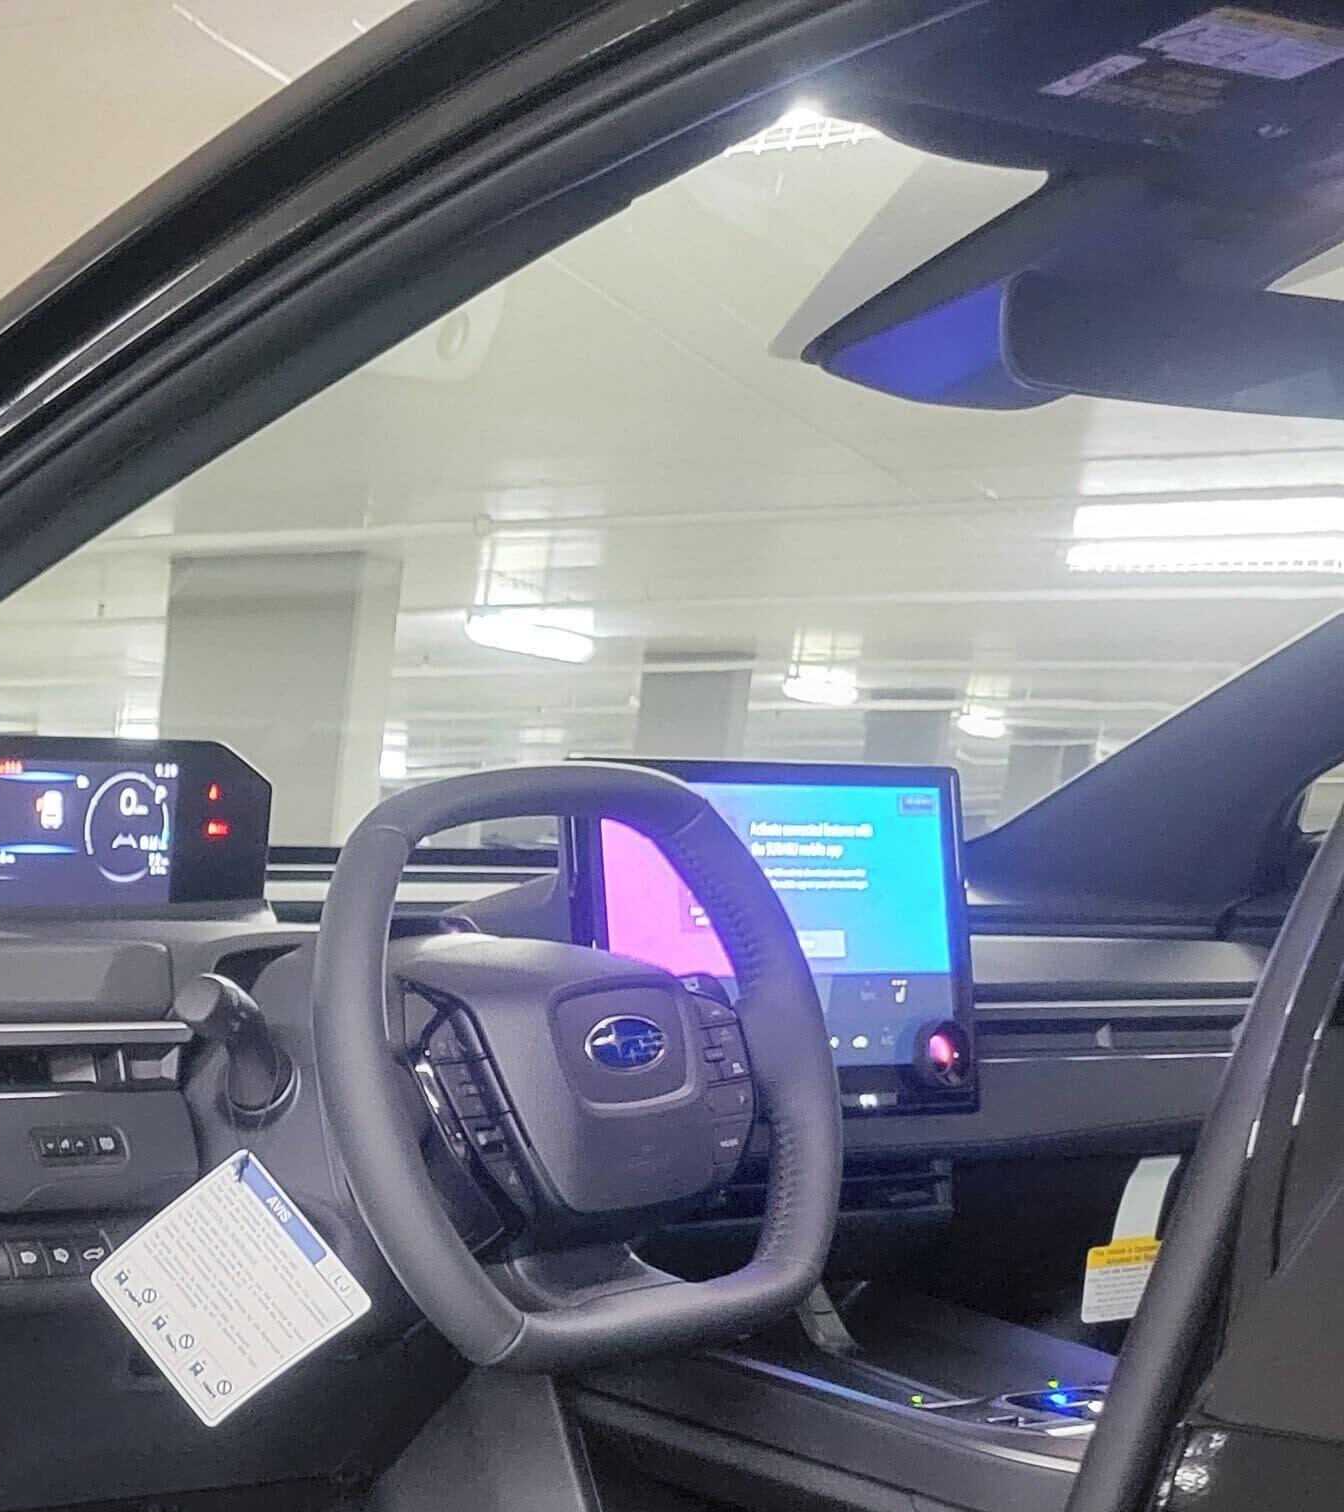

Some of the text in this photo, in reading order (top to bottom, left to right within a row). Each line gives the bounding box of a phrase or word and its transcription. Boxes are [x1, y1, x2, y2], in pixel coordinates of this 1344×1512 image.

[120, 787, 138, 816] 0
[155, 785, 168, 804] P
[265, 1195, 292, 1223] AVIS
